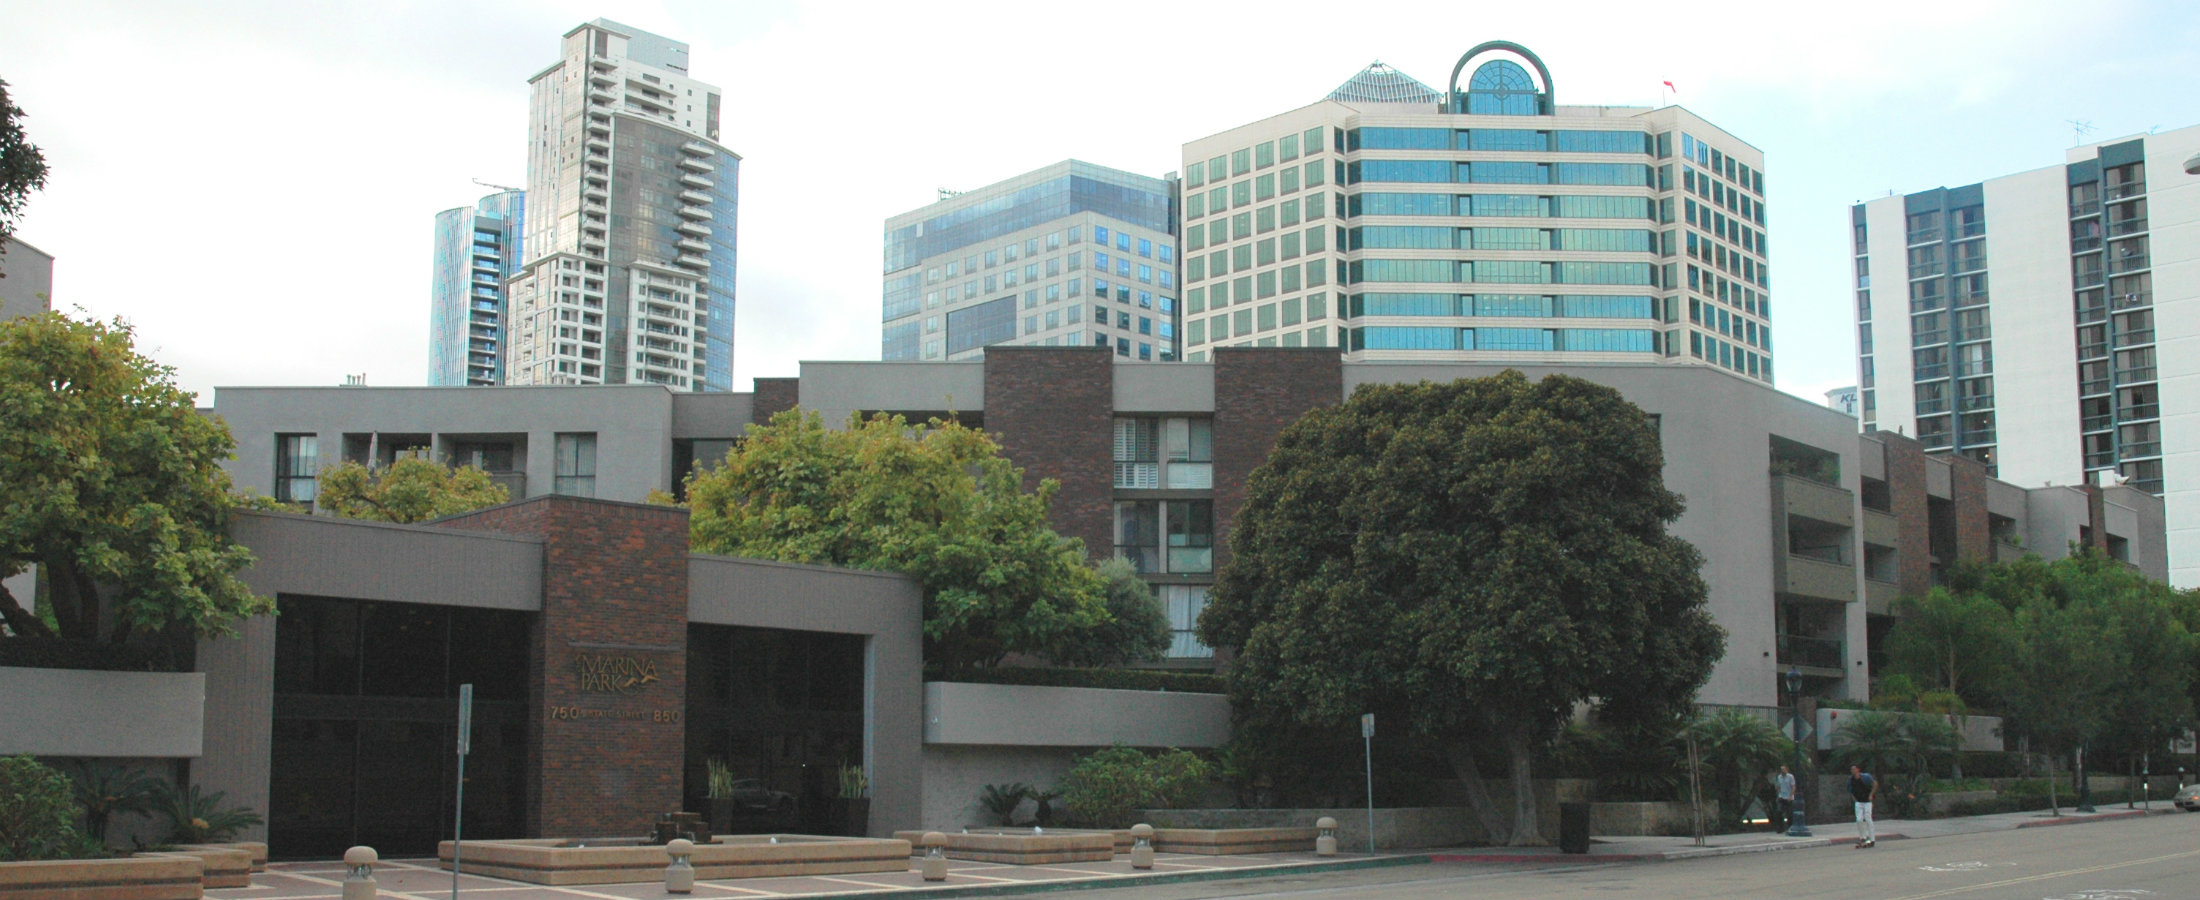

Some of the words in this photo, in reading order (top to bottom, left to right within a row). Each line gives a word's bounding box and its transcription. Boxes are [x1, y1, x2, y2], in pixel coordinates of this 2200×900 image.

[576, 655, 659, 676] MARINA
[582, 673, 624, 692] PARK
[550, 705, 580, 720] 750
[653, 709, 681, 723] 850
